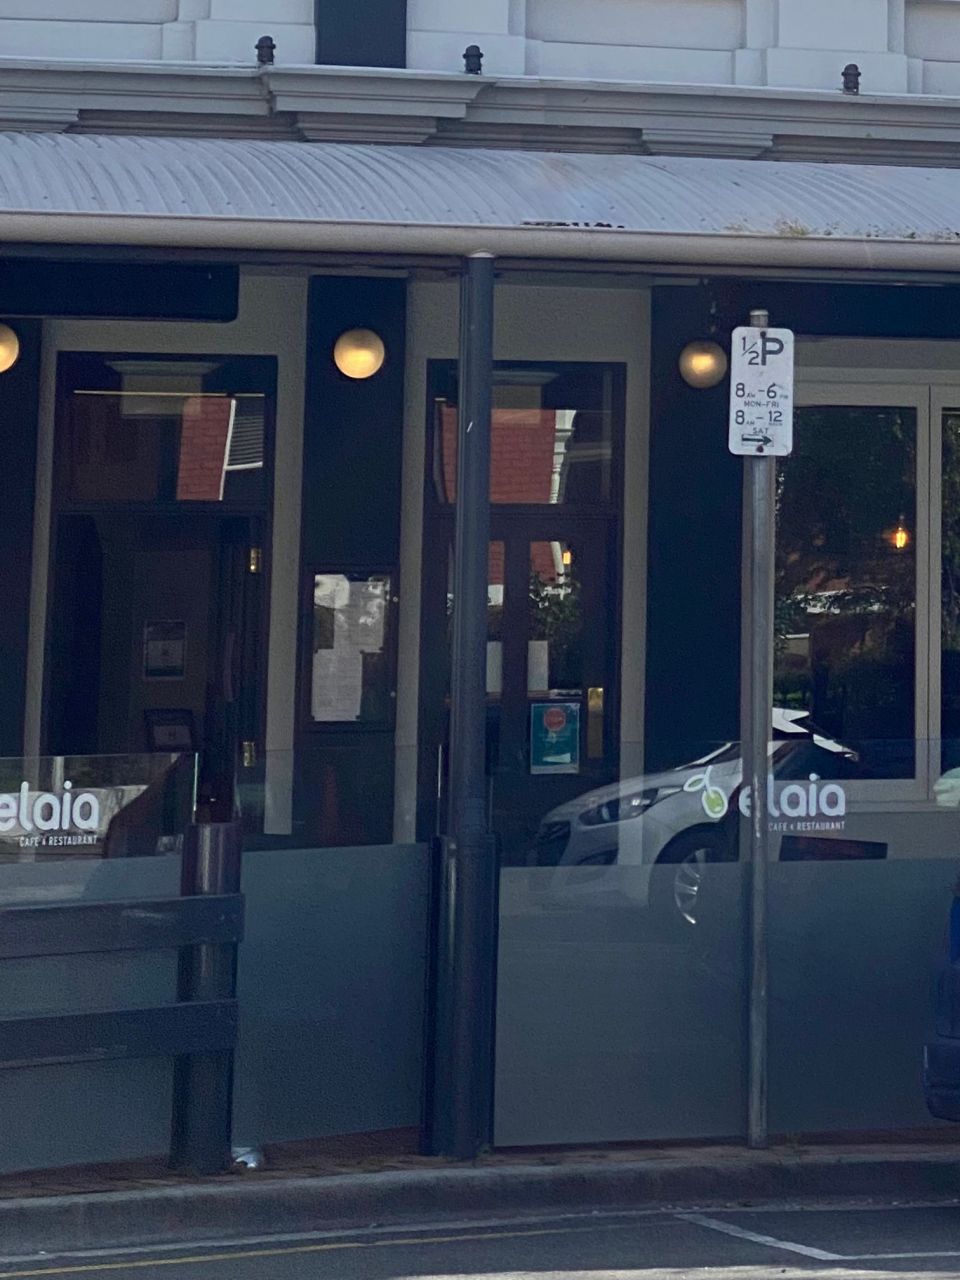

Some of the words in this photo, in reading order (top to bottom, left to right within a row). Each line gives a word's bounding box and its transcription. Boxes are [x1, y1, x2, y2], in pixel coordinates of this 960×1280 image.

[0, 780, 99, 832] elaia
[796, 821, 846, 831] RESTAURANT
[48, 834, 98, 846] RESTAURANT
